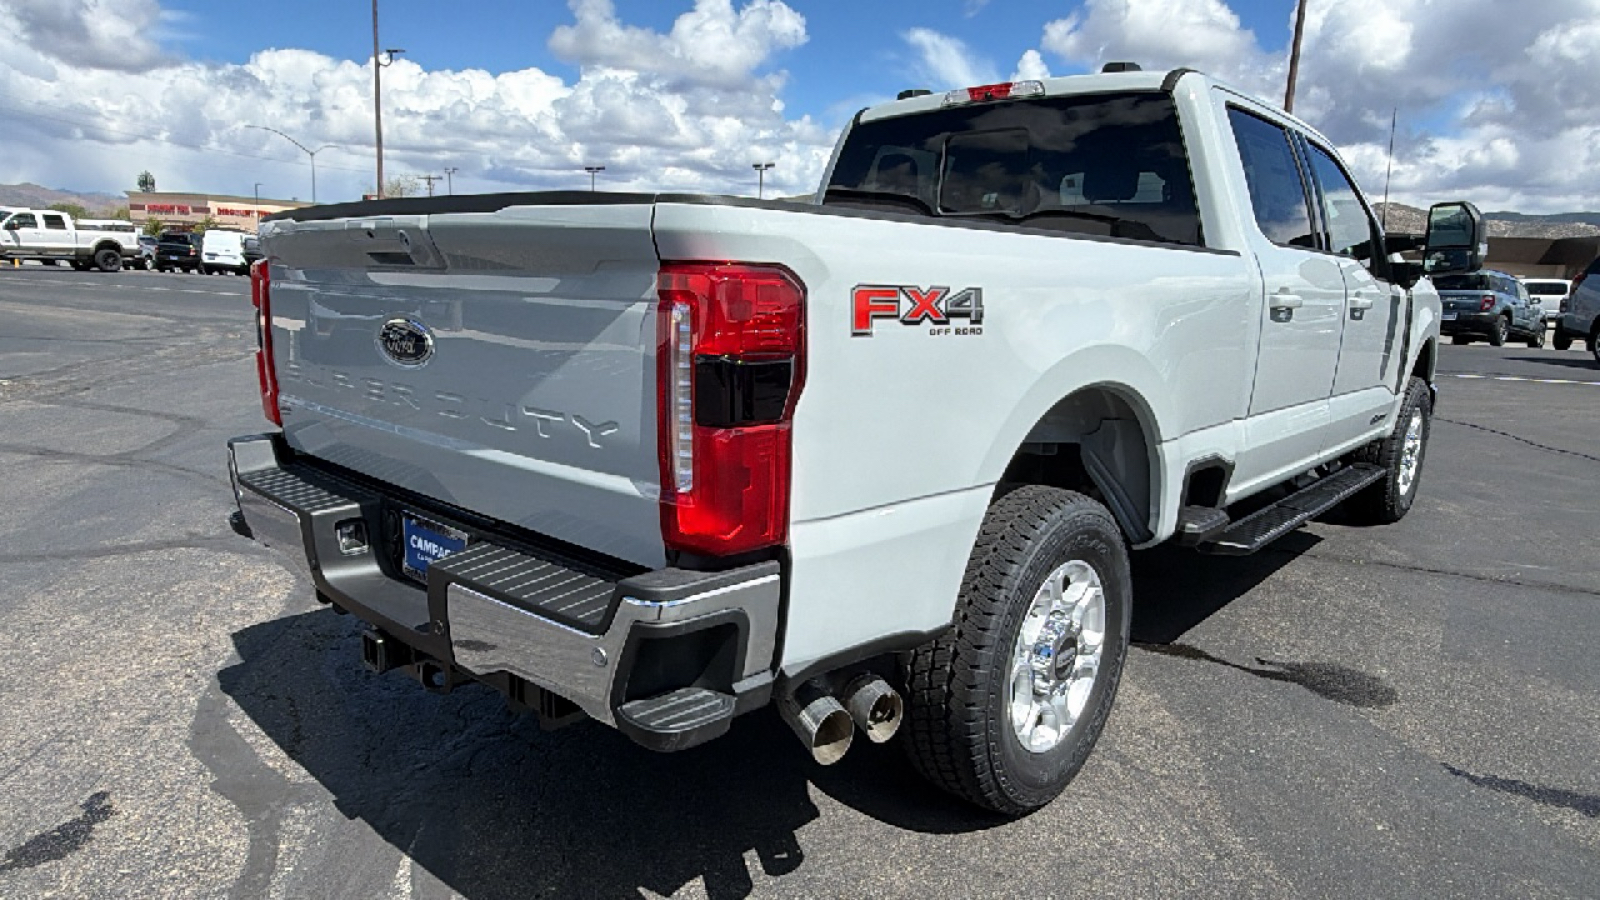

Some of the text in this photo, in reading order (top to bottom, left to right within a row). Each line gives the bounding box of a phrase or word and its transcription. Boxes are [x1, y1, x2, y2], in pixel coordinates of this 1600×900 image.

[851, 284, 984, 337] FX4
[929, 326, 984, 336] OFF ROAD
[434, 389, 620, 449] DUTY
[410, 534, 456, 560] CAMPA
